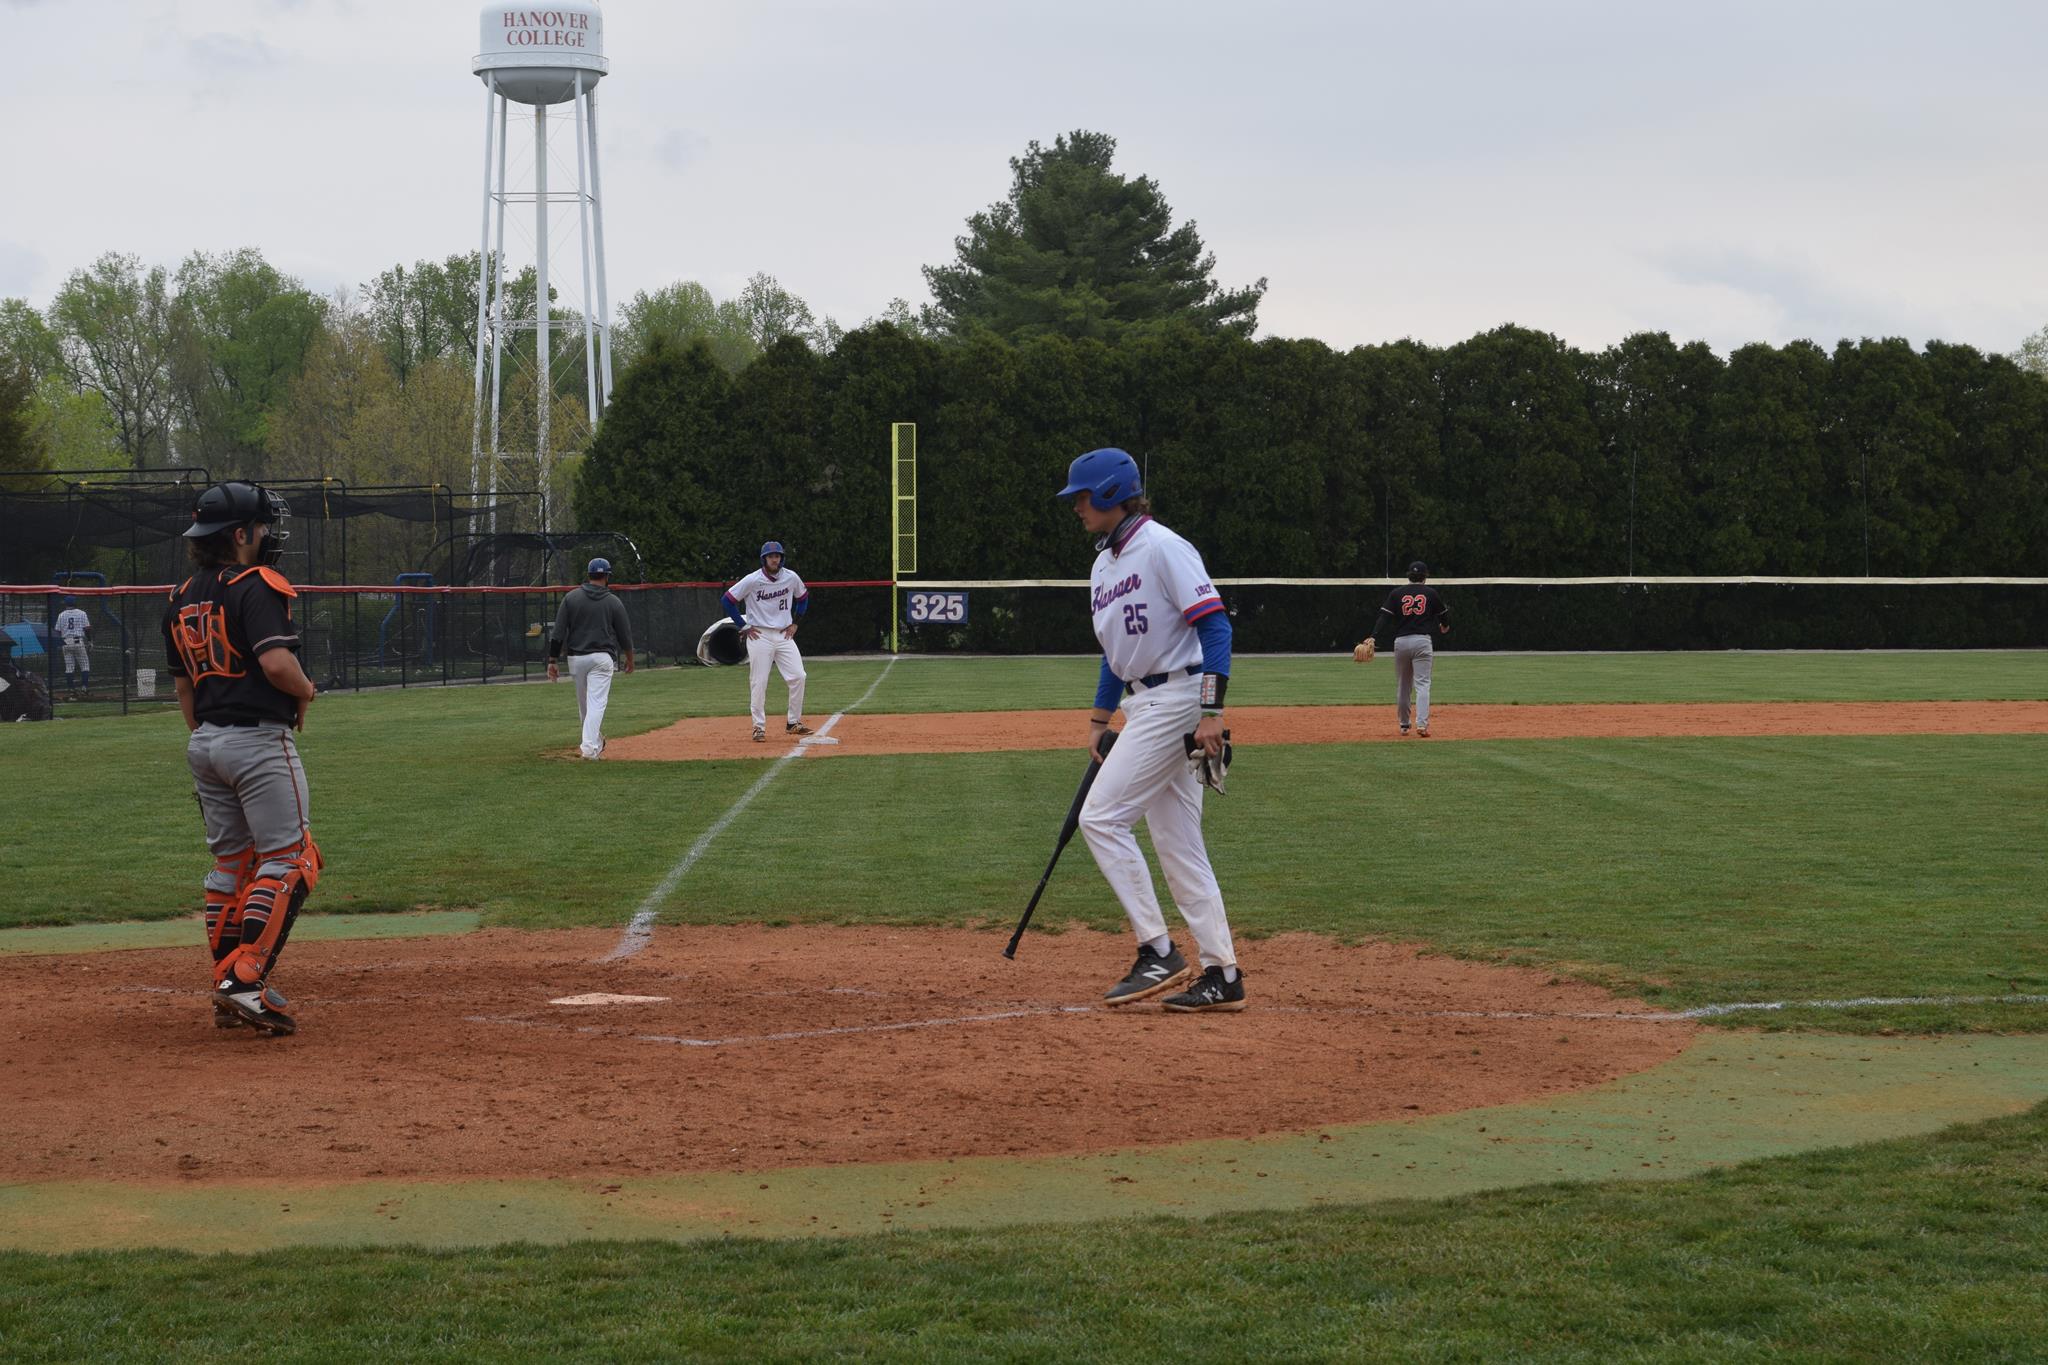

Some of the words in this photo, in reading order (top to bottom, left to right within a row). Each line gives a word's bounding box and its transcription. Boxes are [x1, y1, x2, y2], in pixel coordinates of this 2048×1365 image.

[503, 11, 588, 30] HANOVER
[506, 30, 585, 48] COLLEGE
[756, 587, 789, 602] Hanover
[779, 598, 789, 611] 21
[911, 594, 964, 621] 325
[1401, 594, 1427, 616] 23
[68, 617, 75, 630] 8
[1123, 603, 1148, 635] 25
